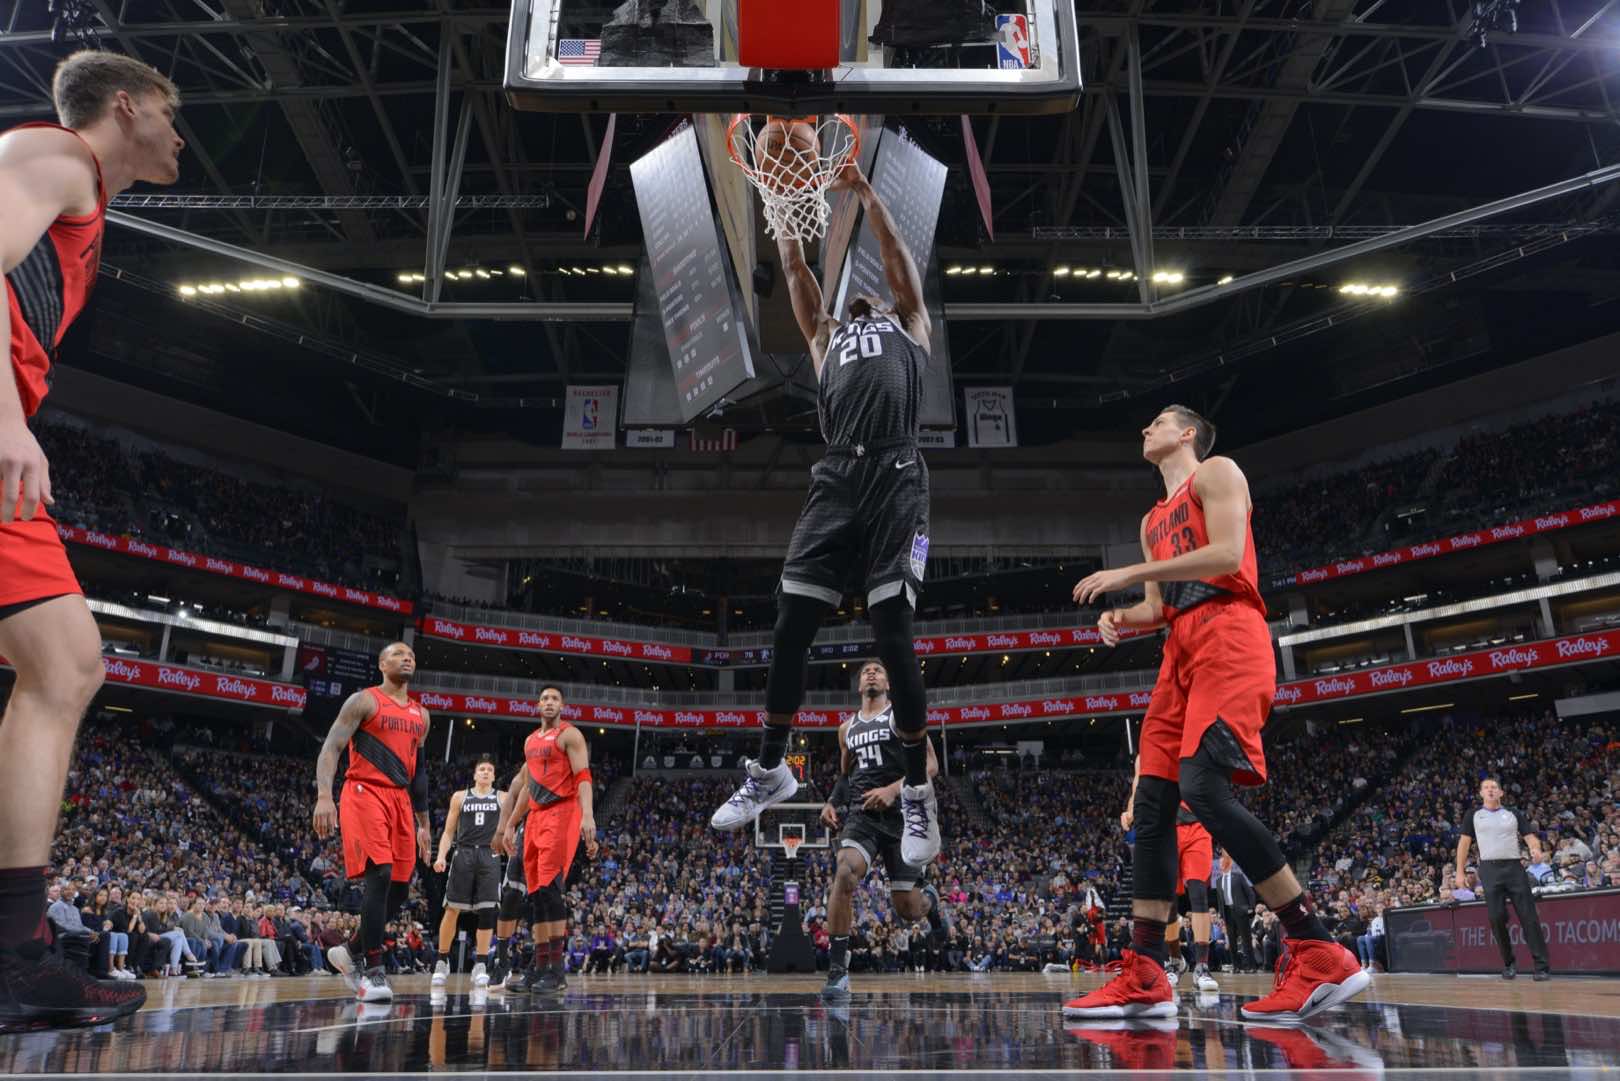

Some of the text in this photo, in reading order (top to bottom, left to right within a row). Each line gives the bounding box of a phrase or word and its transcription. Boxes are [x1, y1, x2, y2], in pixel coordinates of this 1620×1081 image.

[1002, 59, 1019, 69] NBA
[831, 321, 894, 351] KNGS
[840, 334, 883, 367] 20
[1491, 525, 1524, 539] Raley's
[1535, 515, 1569, 529] Raley's
[1580, 505, 1616, 519] Raley's
[158, 667, 200, 690] Raley's
[216, 676, 256, 699] Raley's
[1273, 637, 1609, 703] aley's Raley's Raley's Raley's Raley's Raley's
[420, 692, 453, 710] Raley's
[464, 696, 497, 714] Raley's
[593, 707, 624, 722] Raley's
[675, 711, 704, 723] Raley's
[716, 711, 746, 724] Raley's
[797, 711, 828, 723] Raley's
[960, 707, 991, 721] Raley's
[1001, 703, 1032, 717] Raley's
[1043, 700, 1074, 714] Raley's
[1085, 697, 1118, 711] Raley's
[381, 715, 422, 737] PORTLAN
[847, 728, 891, 750] KINGS
[786, 755, 806, 765] 2:02
[855, 744, 883, 769] 24
[463, 803, 498, 812] KINGS
[475, 812, 485, 826] 8
[1460, 927, 1485, 946] THE
[1555, 917, 1620, 944] TACOM
